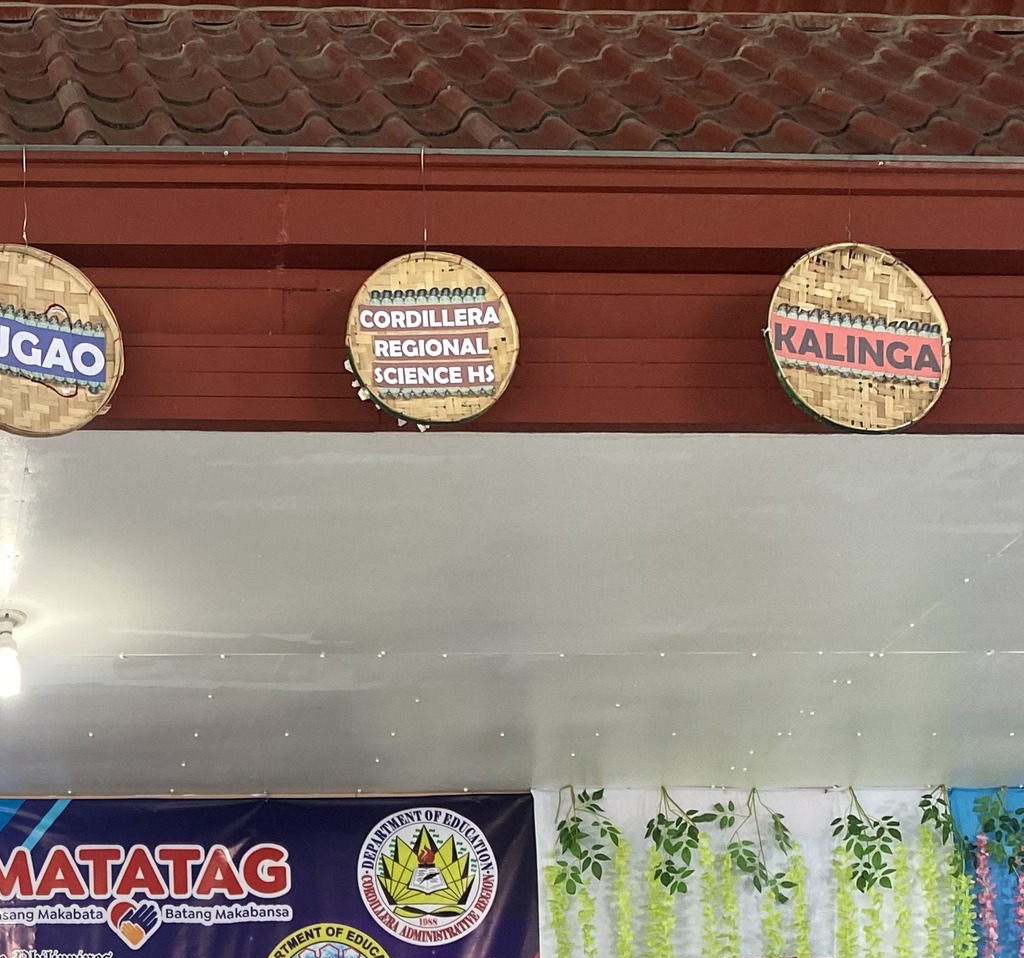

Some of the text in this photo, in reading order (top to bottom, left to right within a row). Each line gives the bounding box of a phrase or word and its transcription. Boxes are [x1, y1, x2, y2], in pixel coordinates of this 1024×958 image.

[360, 307, 500, 329] CORDILLERA
[374, 337, 489, 357] REGIONAL
[774, 322, 941, 373] KALINGA
[373, 364, 495, 386] SCIENCE HS
[361, 809, 494, 871] DEPARTMENT OF EDUCATION
[38, 906, 104, 921] Makabata
[165, 905, 289, 923] Batang Makabansa
[361, 874, 495, 943] CORDILLERA ADMINISTRATIVE REGION
[326, 927, 343, 938] OF
